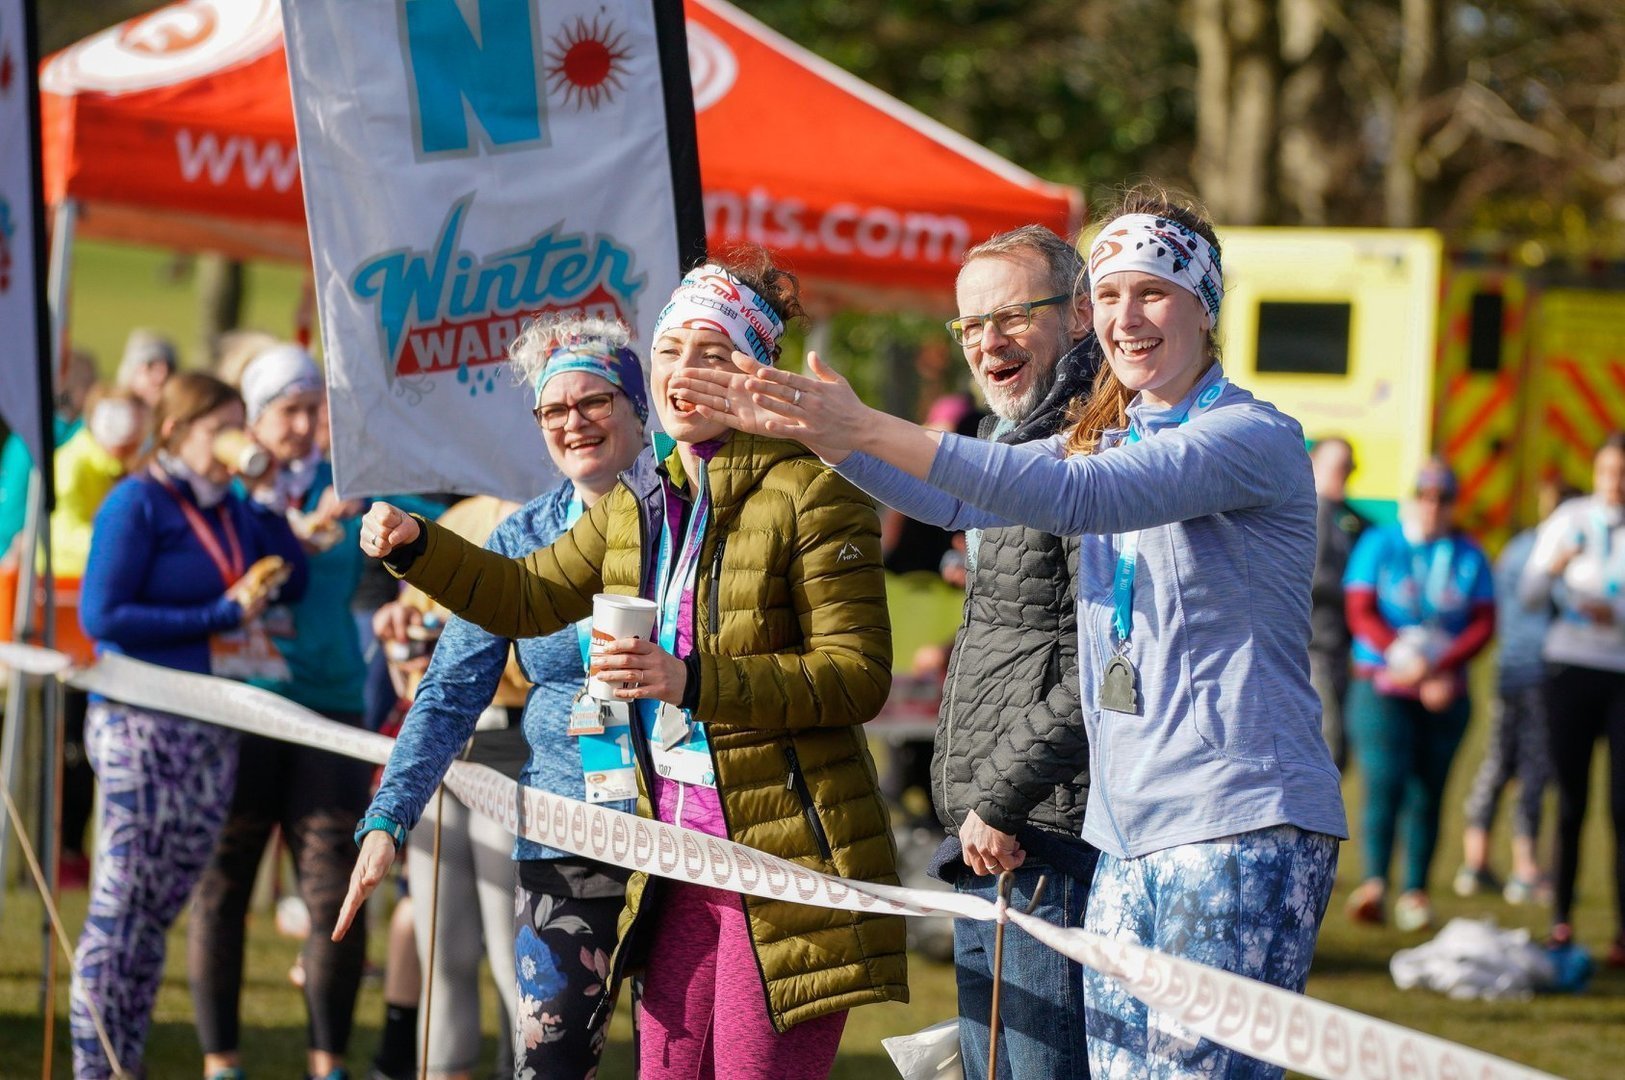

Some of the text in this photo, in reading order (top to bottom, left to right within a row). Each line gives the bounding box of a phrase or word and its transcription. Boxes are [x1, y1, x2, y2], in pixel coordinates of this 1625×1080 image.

[176, 128, 299, 193] ww
[703, 186, 969, 265] nts.com
[352, 200, 645, 377] Winter
